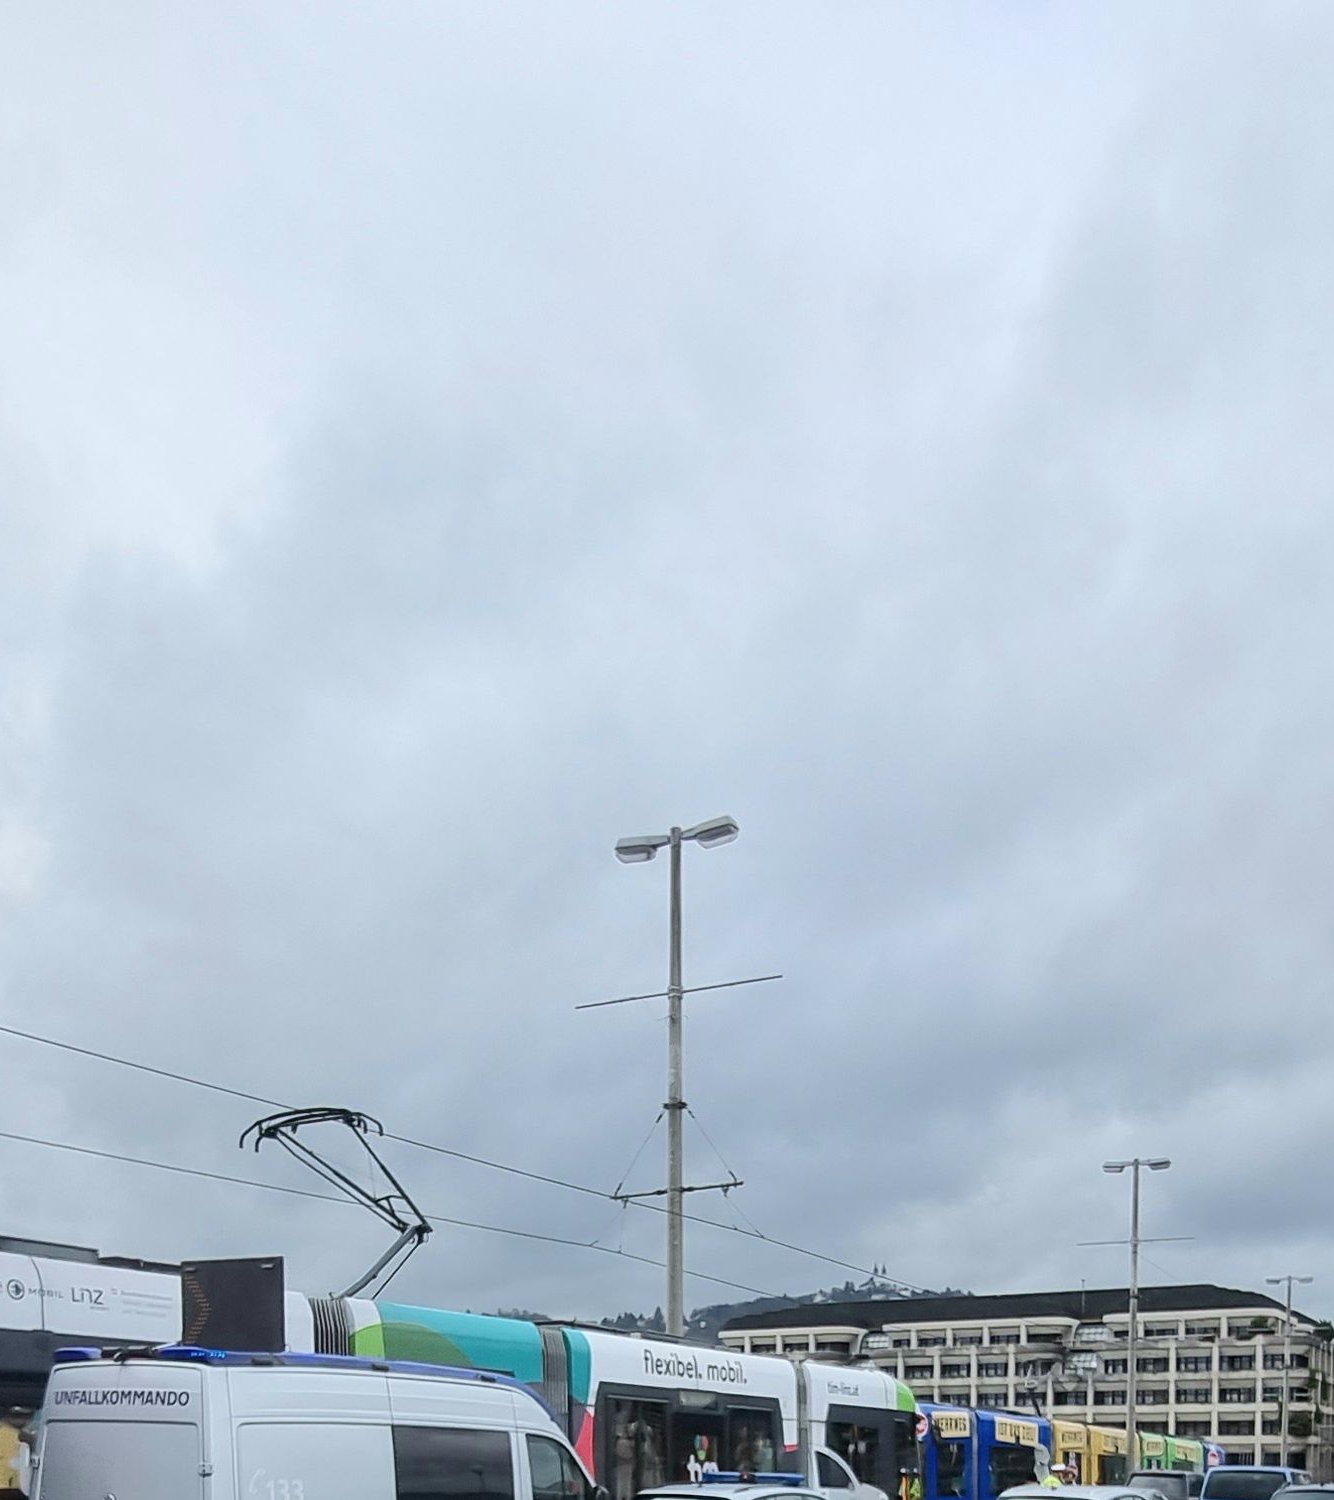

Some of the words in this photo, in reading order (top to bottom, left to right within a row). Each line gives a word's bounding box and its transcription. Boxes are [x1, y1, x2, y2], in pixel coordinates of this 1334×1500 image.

[644, 1349, 702, 1380] flexibel.
[707, 1361, 748, 1385] mobil.
[55, 1390, 191, 1408] UNFALLKOMMANDO
